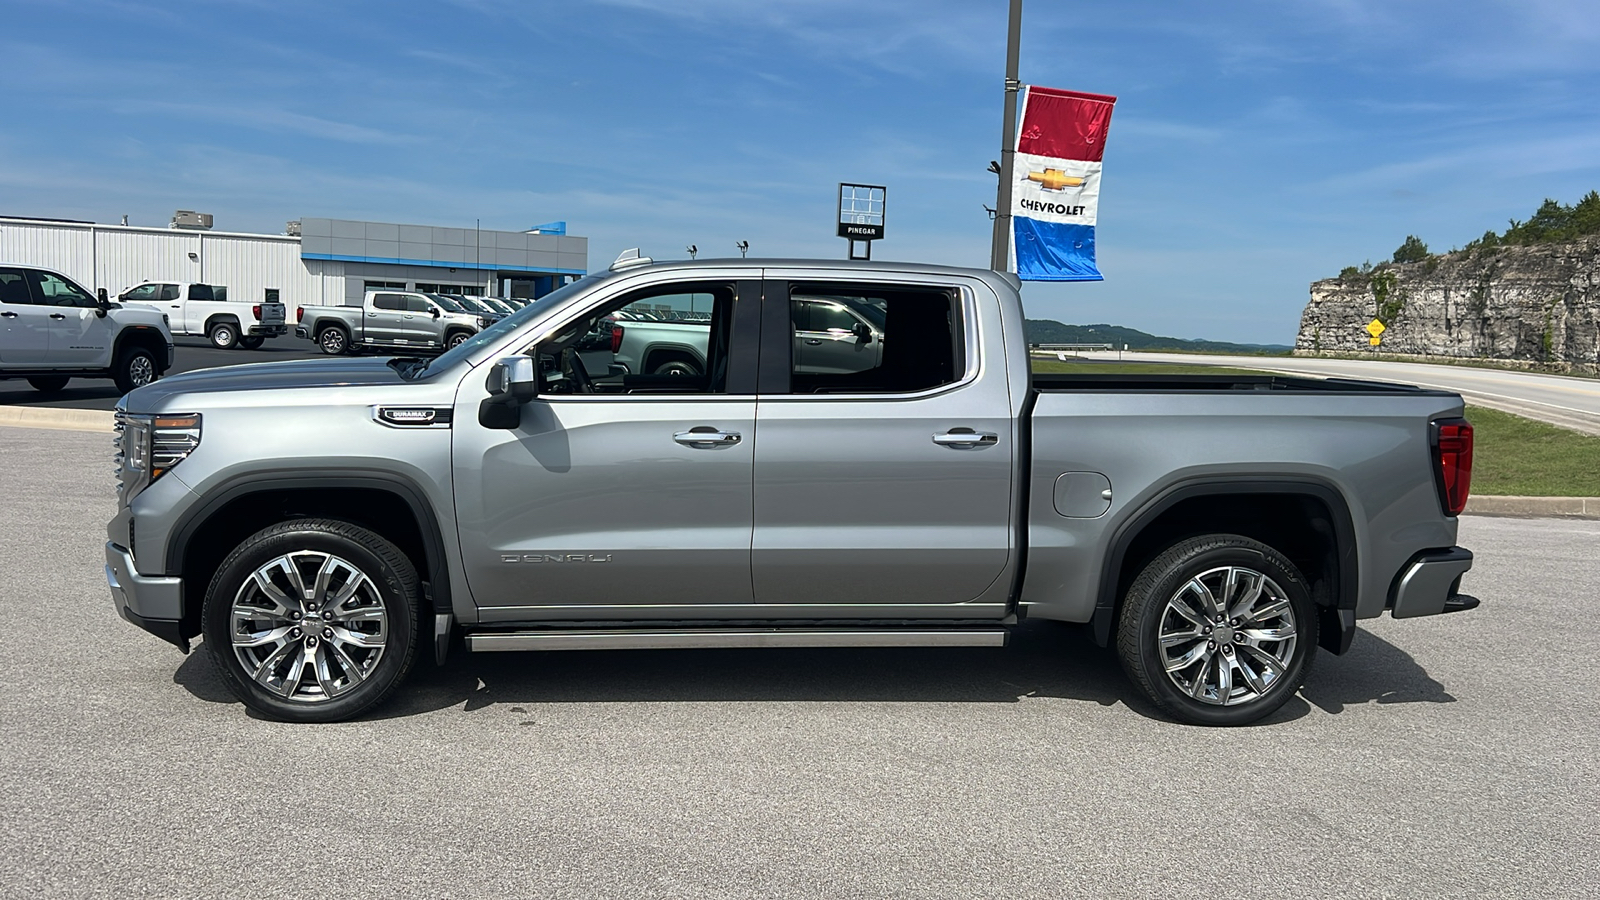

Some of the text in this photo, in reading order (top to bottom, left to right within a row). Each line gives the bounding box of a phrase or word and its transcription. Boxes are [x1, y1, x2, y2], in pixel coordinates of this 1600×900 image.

[1020, 198, 1086, 216] CHEVROLET
[848, 227, 876, 235] PINEGAR
[500, 554, 612, 563] DENALI
[1266, 555, 1294, 578] ALENZA
